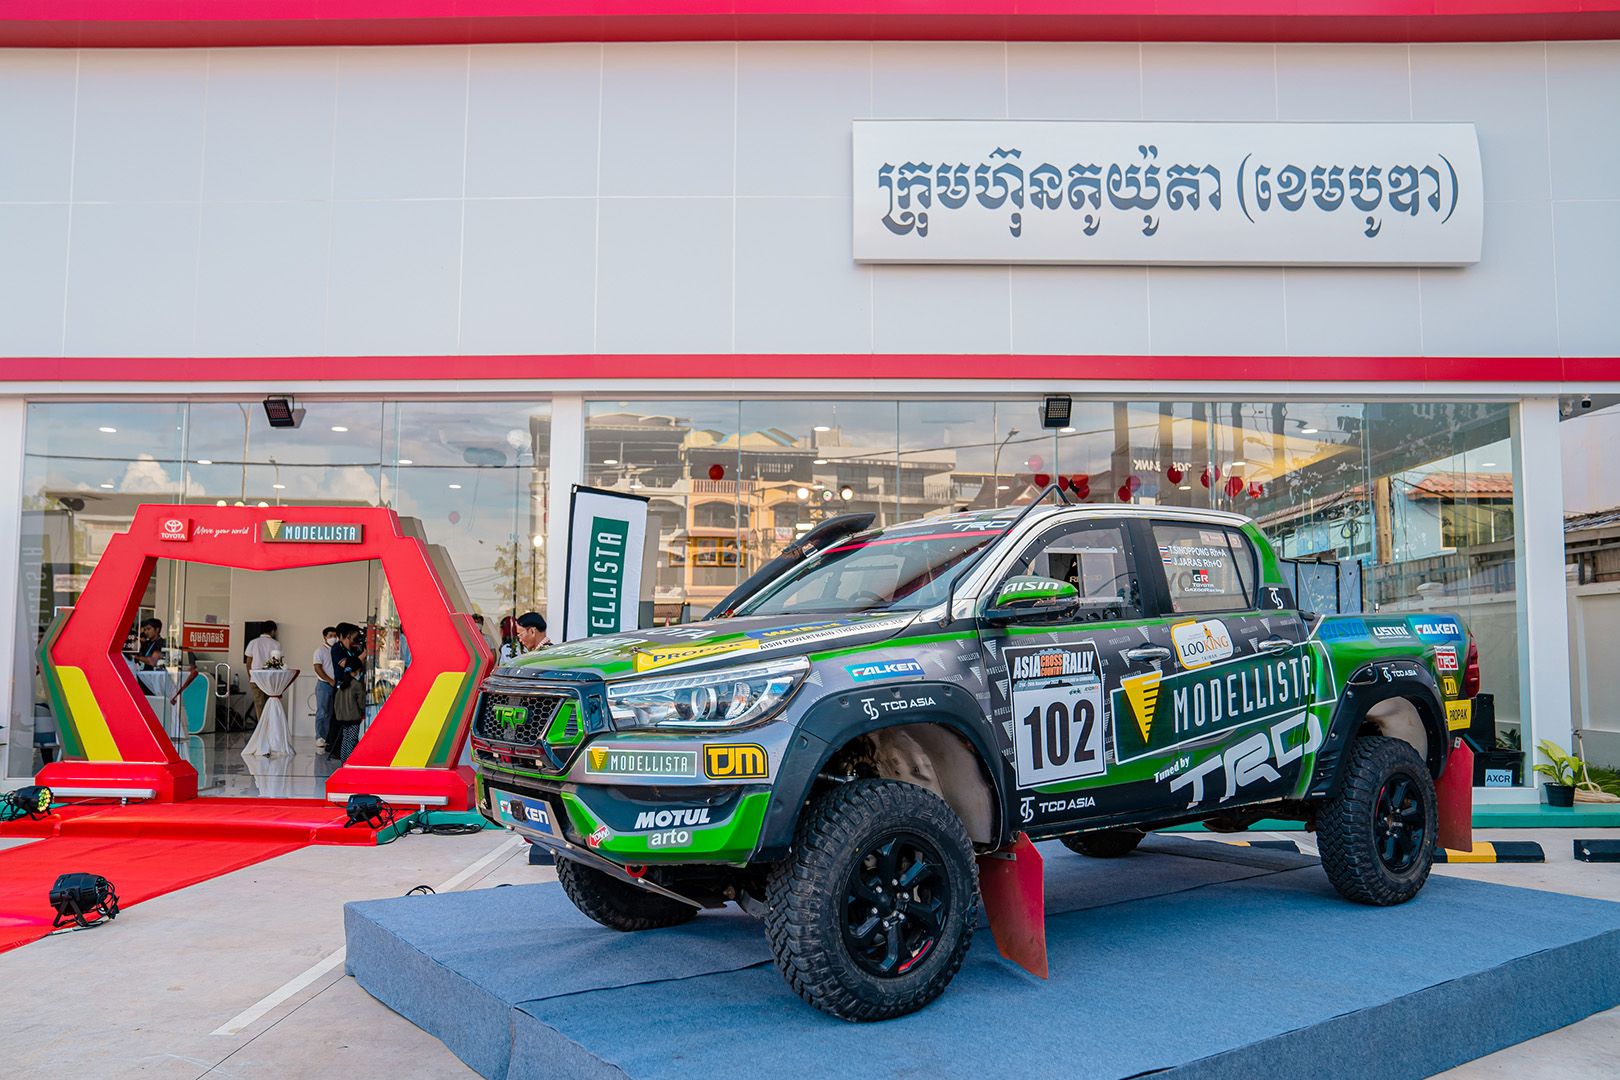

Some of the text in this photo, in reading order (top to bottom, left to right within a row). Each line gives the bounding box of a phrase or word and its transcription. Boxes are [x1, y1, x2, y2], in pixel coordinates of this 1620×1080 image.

[1237, 152, 1459, 237] (ខេមបូឌា)
[194, 526, 250, 538] Move your world
[285, 525, 356, 541] MODELLISTA
[952, 520, 1012, 531] TRD
[591, 532, 623, 636] ELLISTA
[1193, 574, 1209, 582] GR
[1002, 581, 1059, 594] AISIN
[1415, 623, 1459, 635] FALKEN
[759, 640, 783, 650] AISIN
[783, 630, 835, 645] POWERTRAIN
[1181, 635, 1229, 657] LOOKING
[1013, 655, 1041, 679] ASIA
[1040, 654, 1063, 667] CROSS
[1062, 651, 1094, 674] RALLY
[852, 661, 921, 678] FALKEN
[1040, 666, 1063, 677] COUNTRY
[1173, 655, 1315, 734] MODELLISTA
[881, 697, 936, 712] TCD ASIA
[492, 704, 528, 729] TRD
[1449, 708, 1468, 721] PROPAK
[1023, 699, 1095, 770] 102
[610, 755, 688, 772] MODELLISTA
[708, 747, 764, 776] TJM
[1169, 710, 1323, 809] TRD
[1154, 757, 1191, 783] Tuned by
[1486, 774, 1511, 783] AXCR
[500, 799, 550, 825] FKEN
[1039, 796, 1096, 813] TCD ASIA
[634, 808, 711, 829] MOTUL
[651, 829, 689, 846] arto
